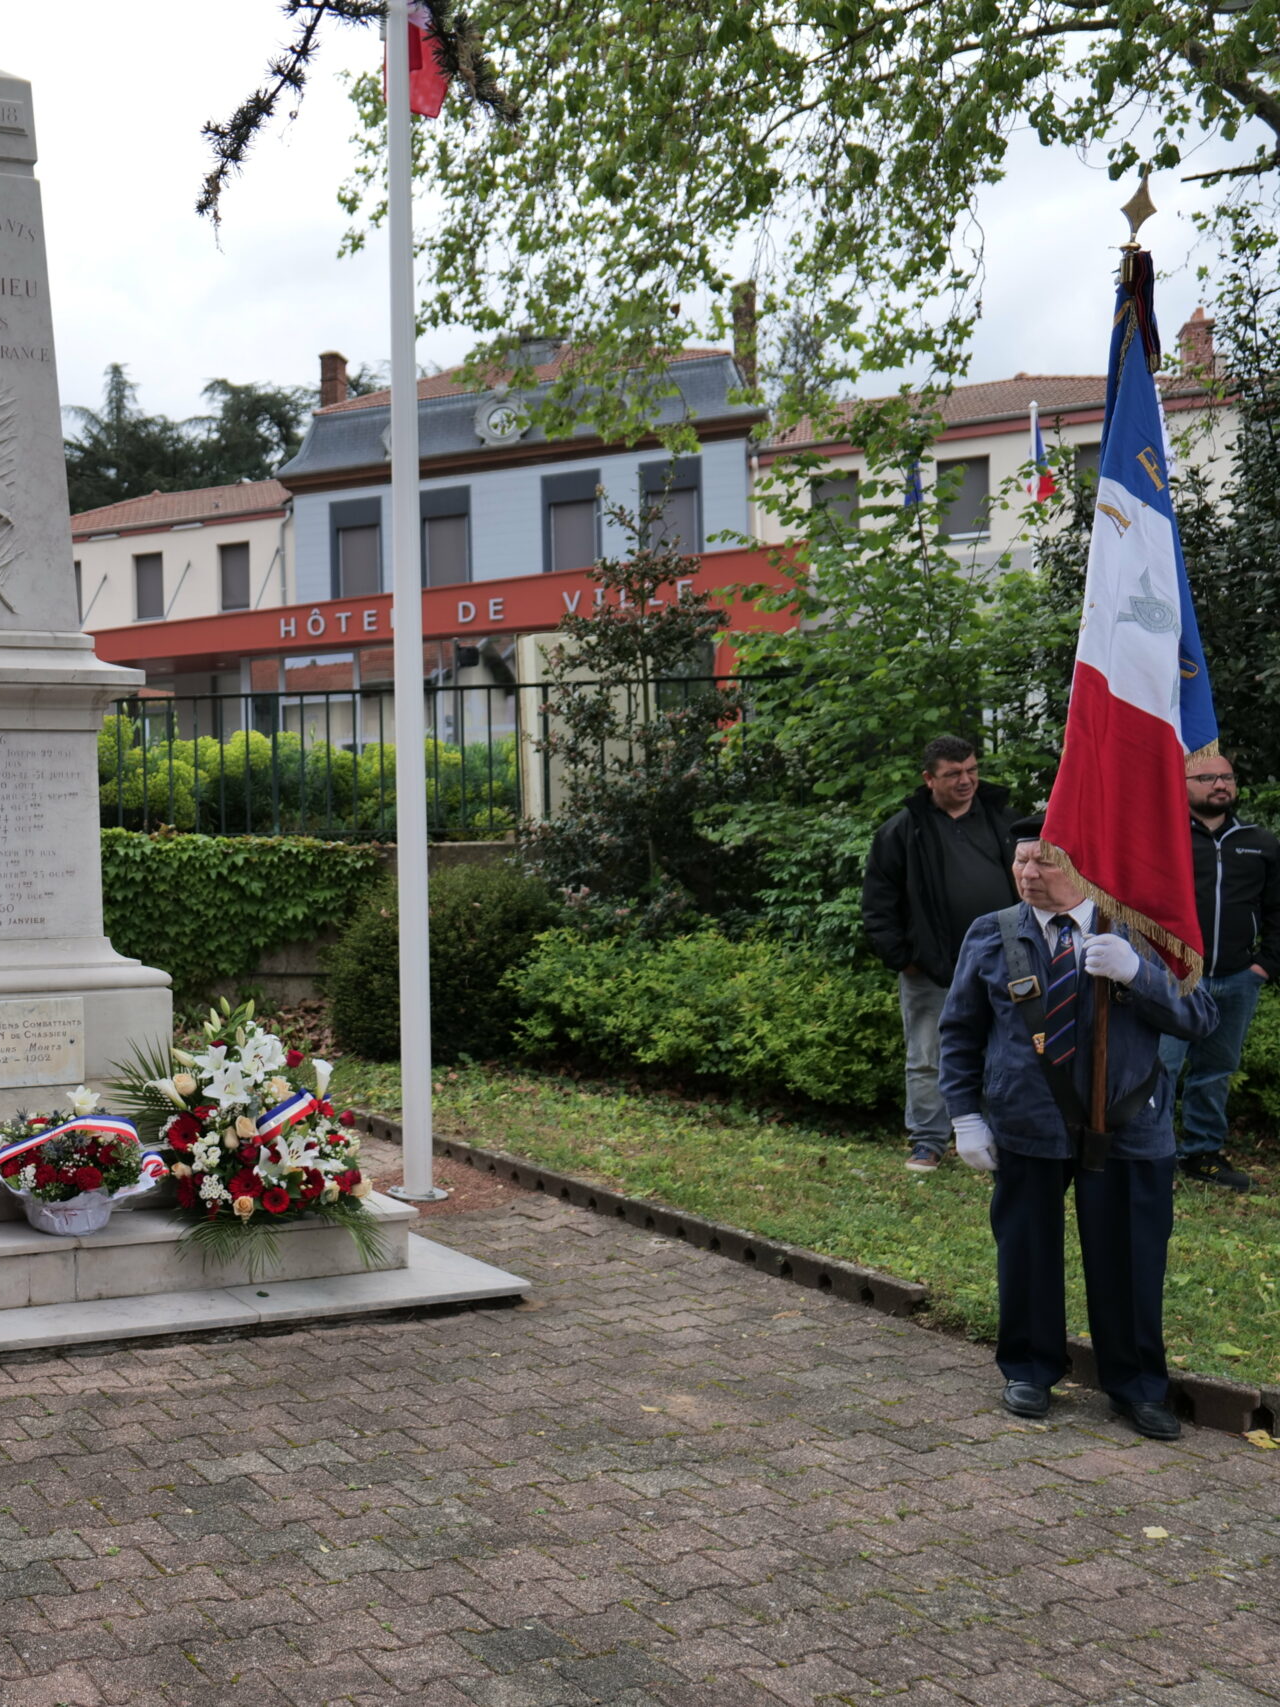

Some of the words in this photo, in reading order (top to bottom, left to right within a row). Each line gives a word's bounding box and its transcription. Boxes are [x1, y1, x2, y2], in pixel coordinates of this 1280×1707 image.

[279, 607, 396, 639] HÔTE
[457, 597, 505, 624] DE
[8, 916, 46, 926] JANVIER
